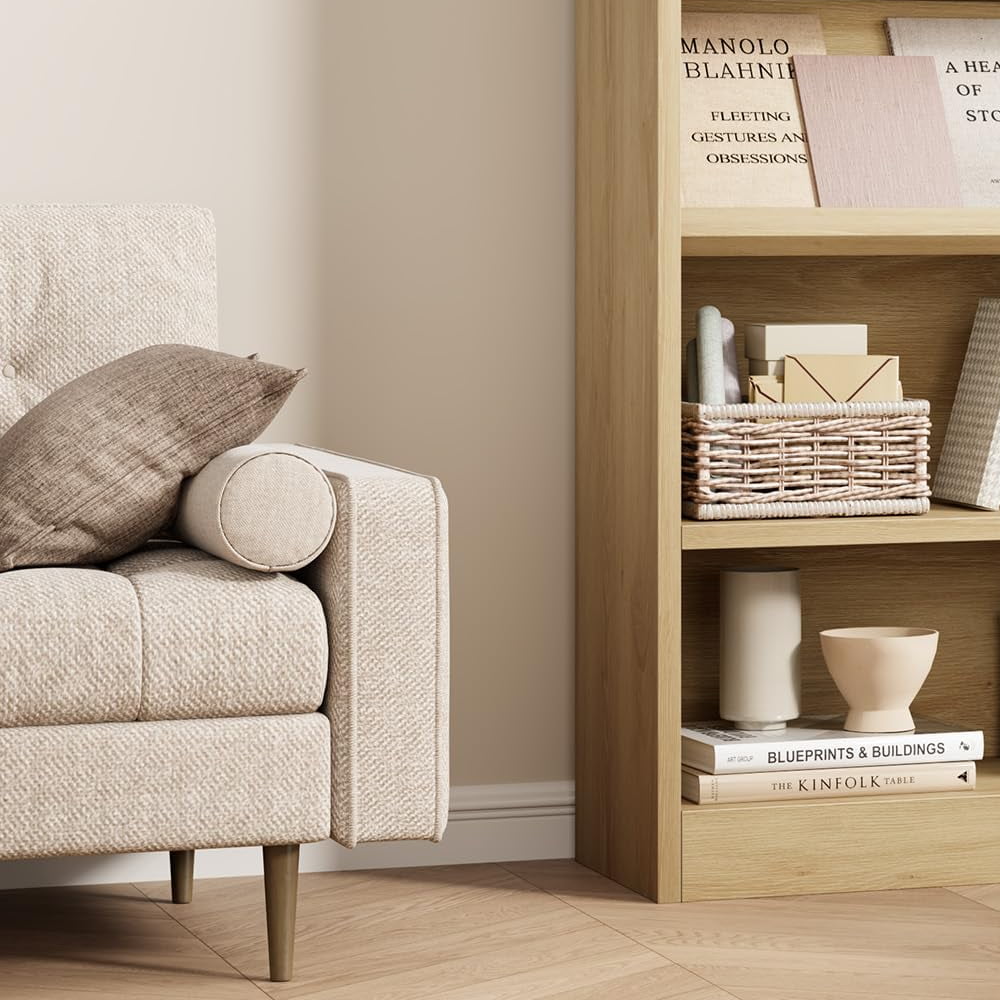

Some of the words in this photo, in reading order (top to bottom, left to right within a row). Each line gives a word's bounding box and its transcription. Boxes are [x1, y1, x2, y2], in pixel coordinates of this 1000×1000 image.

[681, 38, 789, 55] MANOLO
[945, 61, 959, 74] A
[956, 84, 982, 96] OF
[711, 111, 791, 121] FLEETING
[691, 132, 777, 143] GESTURES
[706, 153, 808, 164] OBSESSIONS
[768, 747, 854, 764] BLUEPRINTS
[858, 748, 867, 758] &
[872, 742, 945, 758] BUILDINGS
[771, 782, 793, 790] THE
[799, 776, 881, 792] KINFOLK
[884, 776, 915, 785] TABLE
